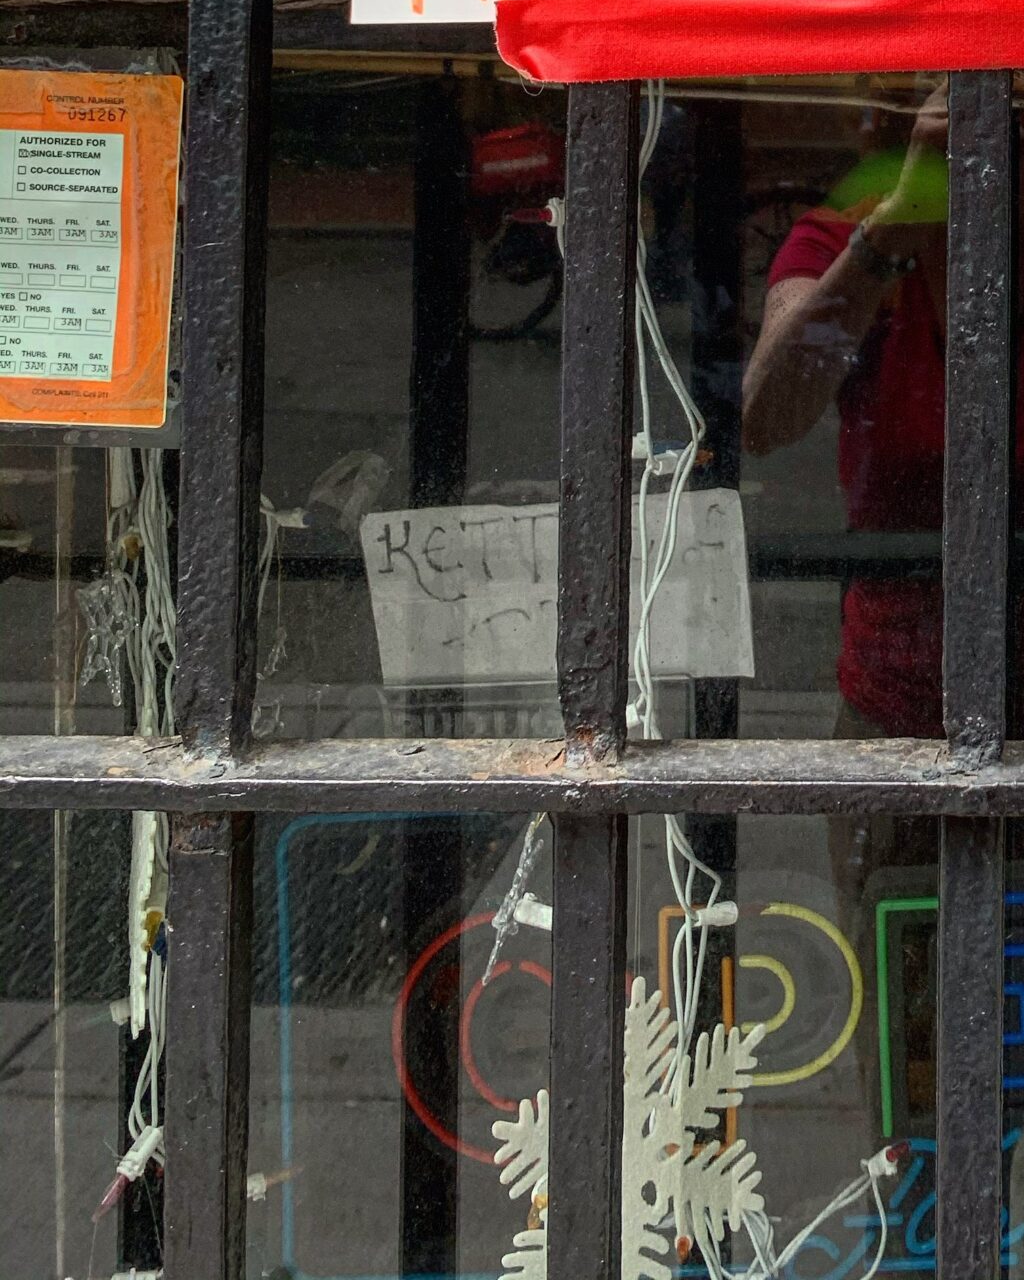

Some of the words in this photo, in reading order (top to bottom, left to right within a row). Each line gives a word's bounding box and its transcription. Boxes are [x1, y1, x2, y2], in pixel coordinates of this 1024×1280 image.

[46, 95, 86, 104] CONTROL
[87, 96, 125, 105] NUMBER
[67, 106, 127, 122] 091267
[20, 136, 83, 146] AUTHORIZED
[86, 138, 106, 147] FOR
[30, 150, 101, 159] SINGLE-STREAM
[30, 166, 101, 176] CO-COLLECTION
[29, 183, 118, 194] SOURCE-SEPARATED
[27, 217, 55, 225] THURS.
[1, 292, 16, 300] YES
[30, 293, 42, 301] NO
[25, 305, 52, 313] THURS.
[9, 337, 21, 345] NO
[22, 350, 48, 358] THURS.
